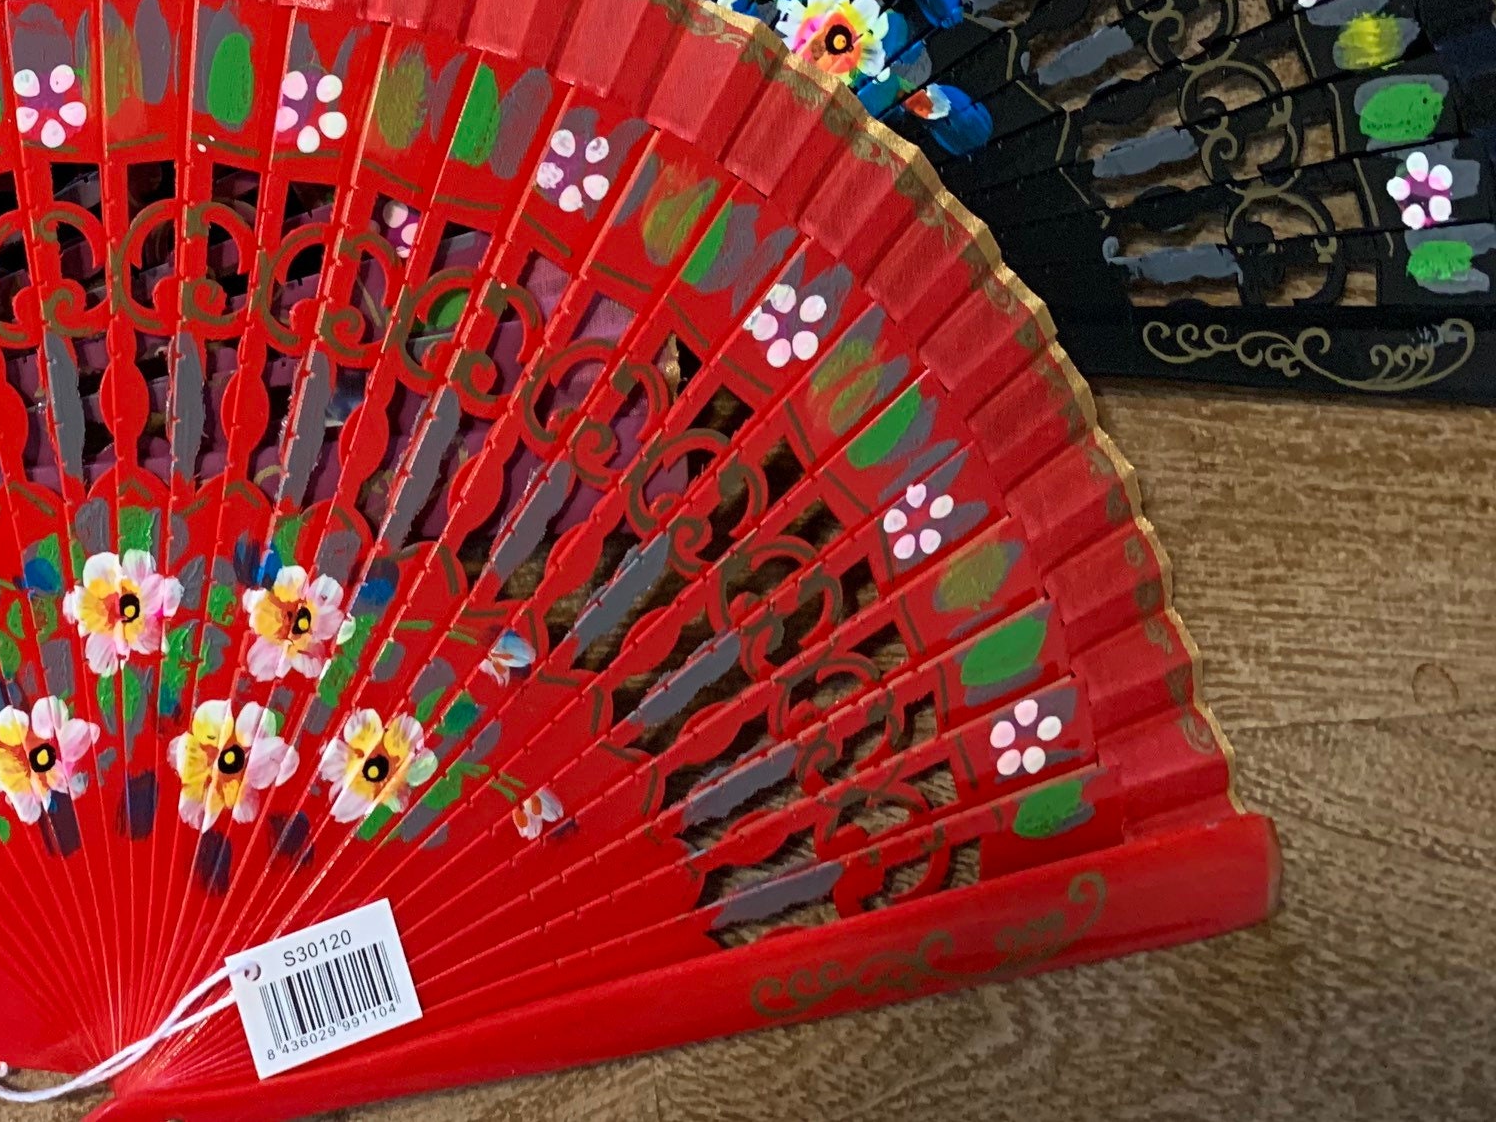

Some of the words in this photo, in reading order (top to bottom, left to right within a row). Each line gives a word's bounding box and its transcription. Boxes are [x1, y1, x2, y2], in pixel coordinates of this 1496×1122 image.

[283, 929, 352, 967] S30120
[267, 1048, 276, 1061] 8
[281, 1026, 337, 1055] 436029
[342, 1003, 397, 1032] 991104
